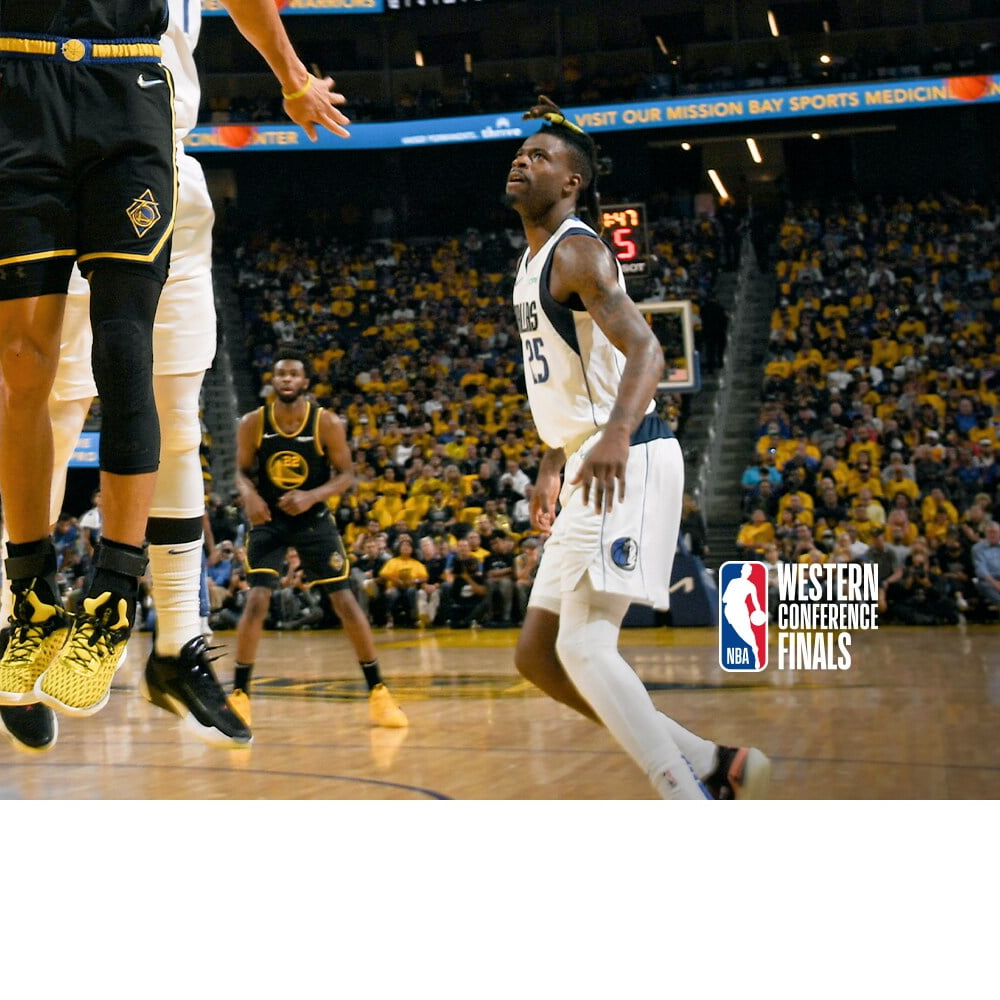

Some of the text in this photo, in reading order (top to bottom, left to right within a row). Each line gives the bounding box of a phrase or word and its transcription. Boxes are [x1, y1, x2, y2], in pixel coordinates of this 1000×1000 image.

[574, 111, 617, 127] VISIT
[622, 107, 662, 125] OUR
[666, 101, 743, 121] MISSION
[748, 98, 784, 115] BAY
[789, 91, 860, 112] SPORTS
[614, 228, 637, 260] 5
[526, 337, 549, 384] 25
